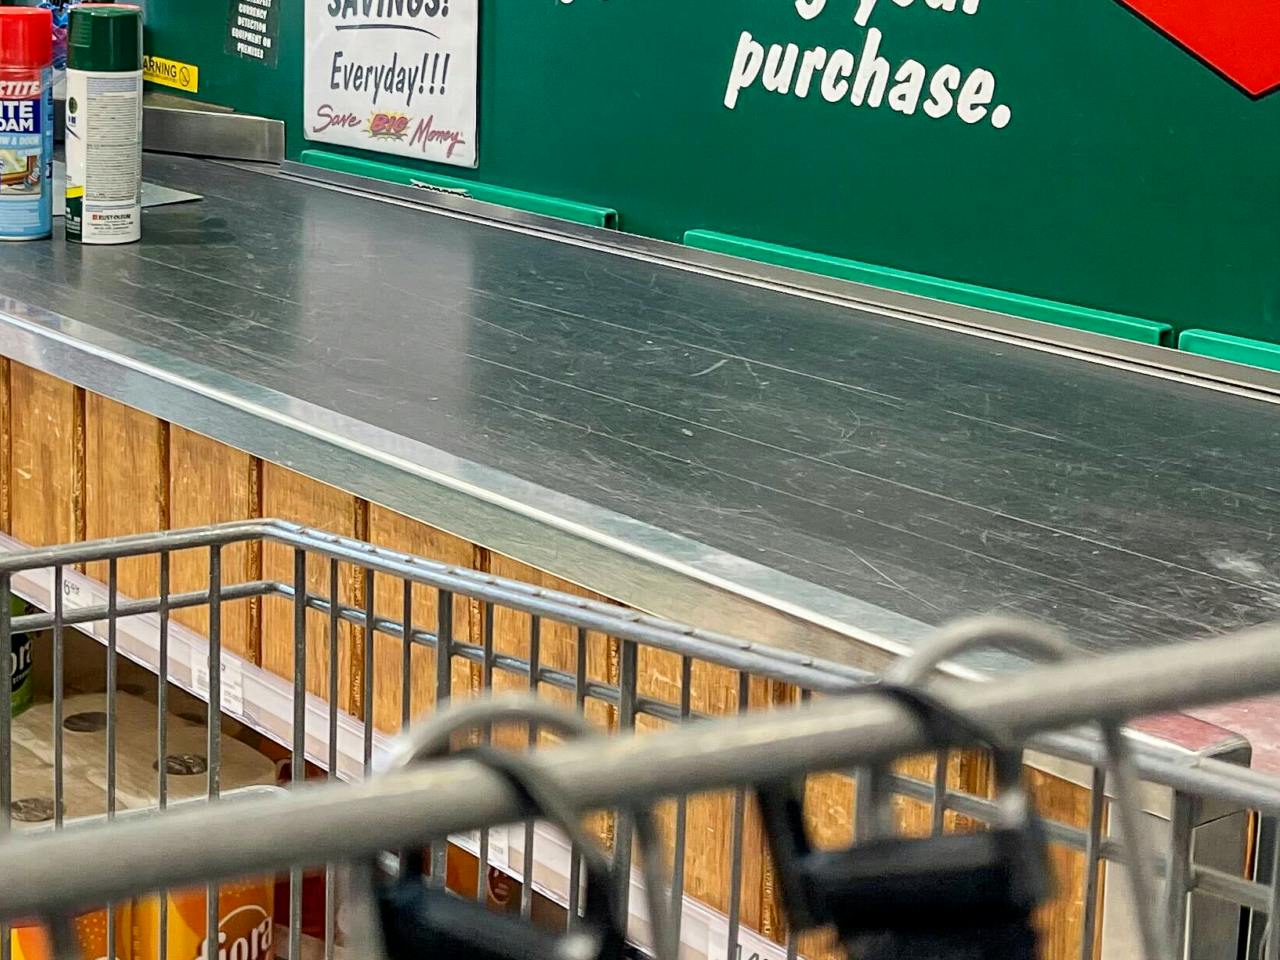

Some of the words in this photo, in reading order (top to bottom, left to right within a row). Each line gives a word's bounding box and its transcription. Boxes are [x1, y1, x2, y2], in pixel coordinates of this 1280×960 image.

[231, 27, 262, 45] EQUIPMENT
[262, 37, 272, 48] ON
[237, 16, 267, 33] DETECTION
[143, 55, 177, 78] ARNING
[330, 50, 451, 107] Everyday!!!
[723, 27, 1011, 129] purchase.
[312, 103, 362, 133] Save
